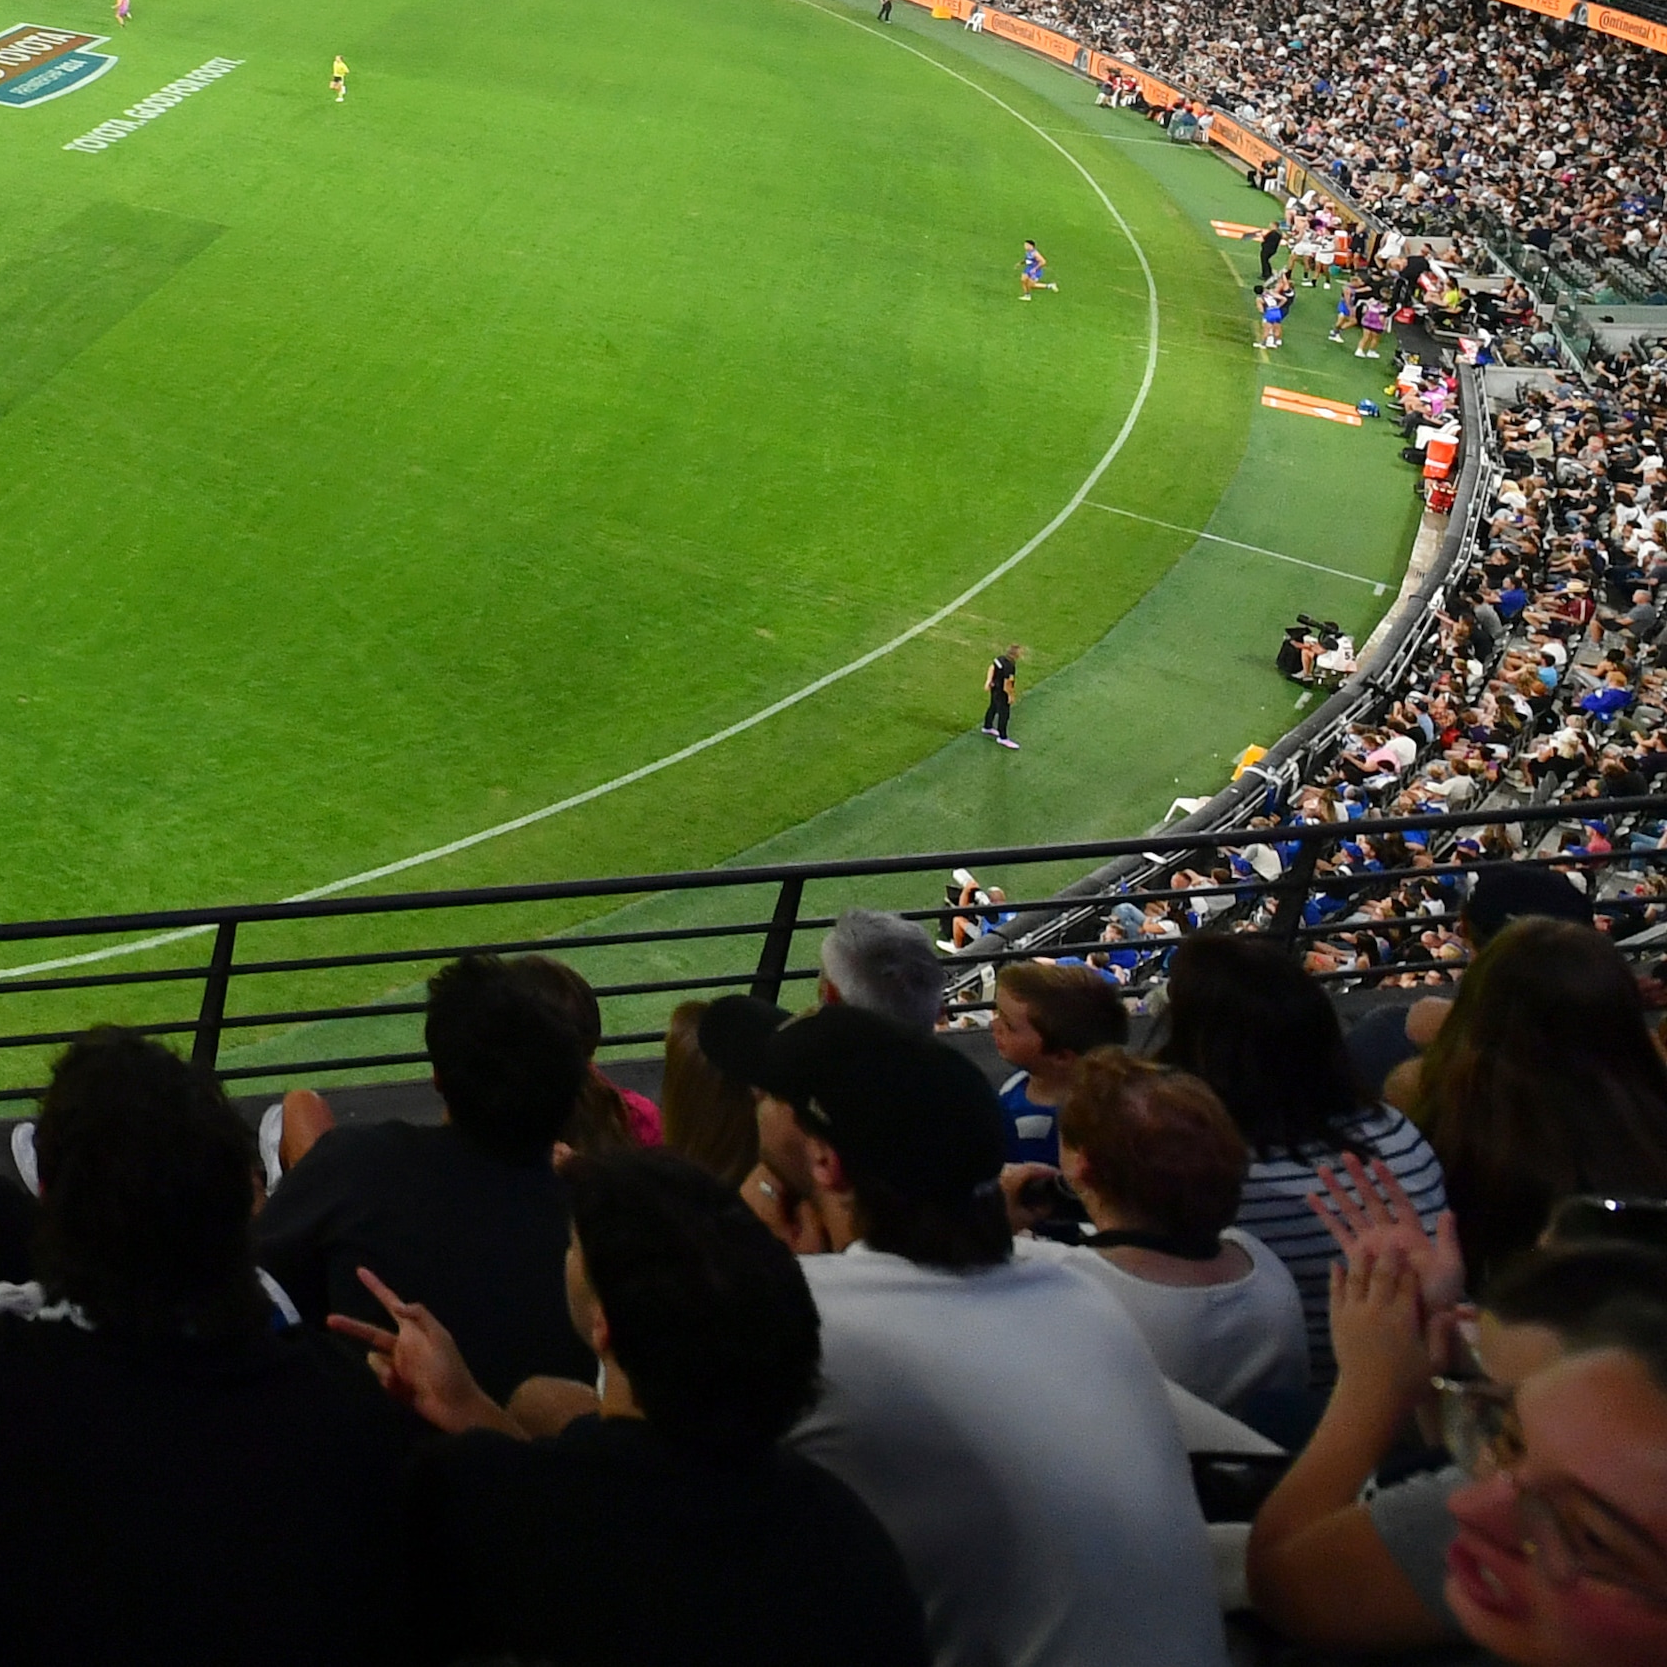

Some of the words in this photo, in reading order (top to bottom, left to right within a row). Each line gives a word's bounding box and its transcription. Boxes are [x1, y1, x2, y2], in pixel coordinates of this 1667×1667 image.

[991, 13, 1035, 40] Continental
[1043, 33, 1067, 56] TYRES
[1598, 10, 1650, 40] Continental
[123, 91, 184, 120] GOOD
